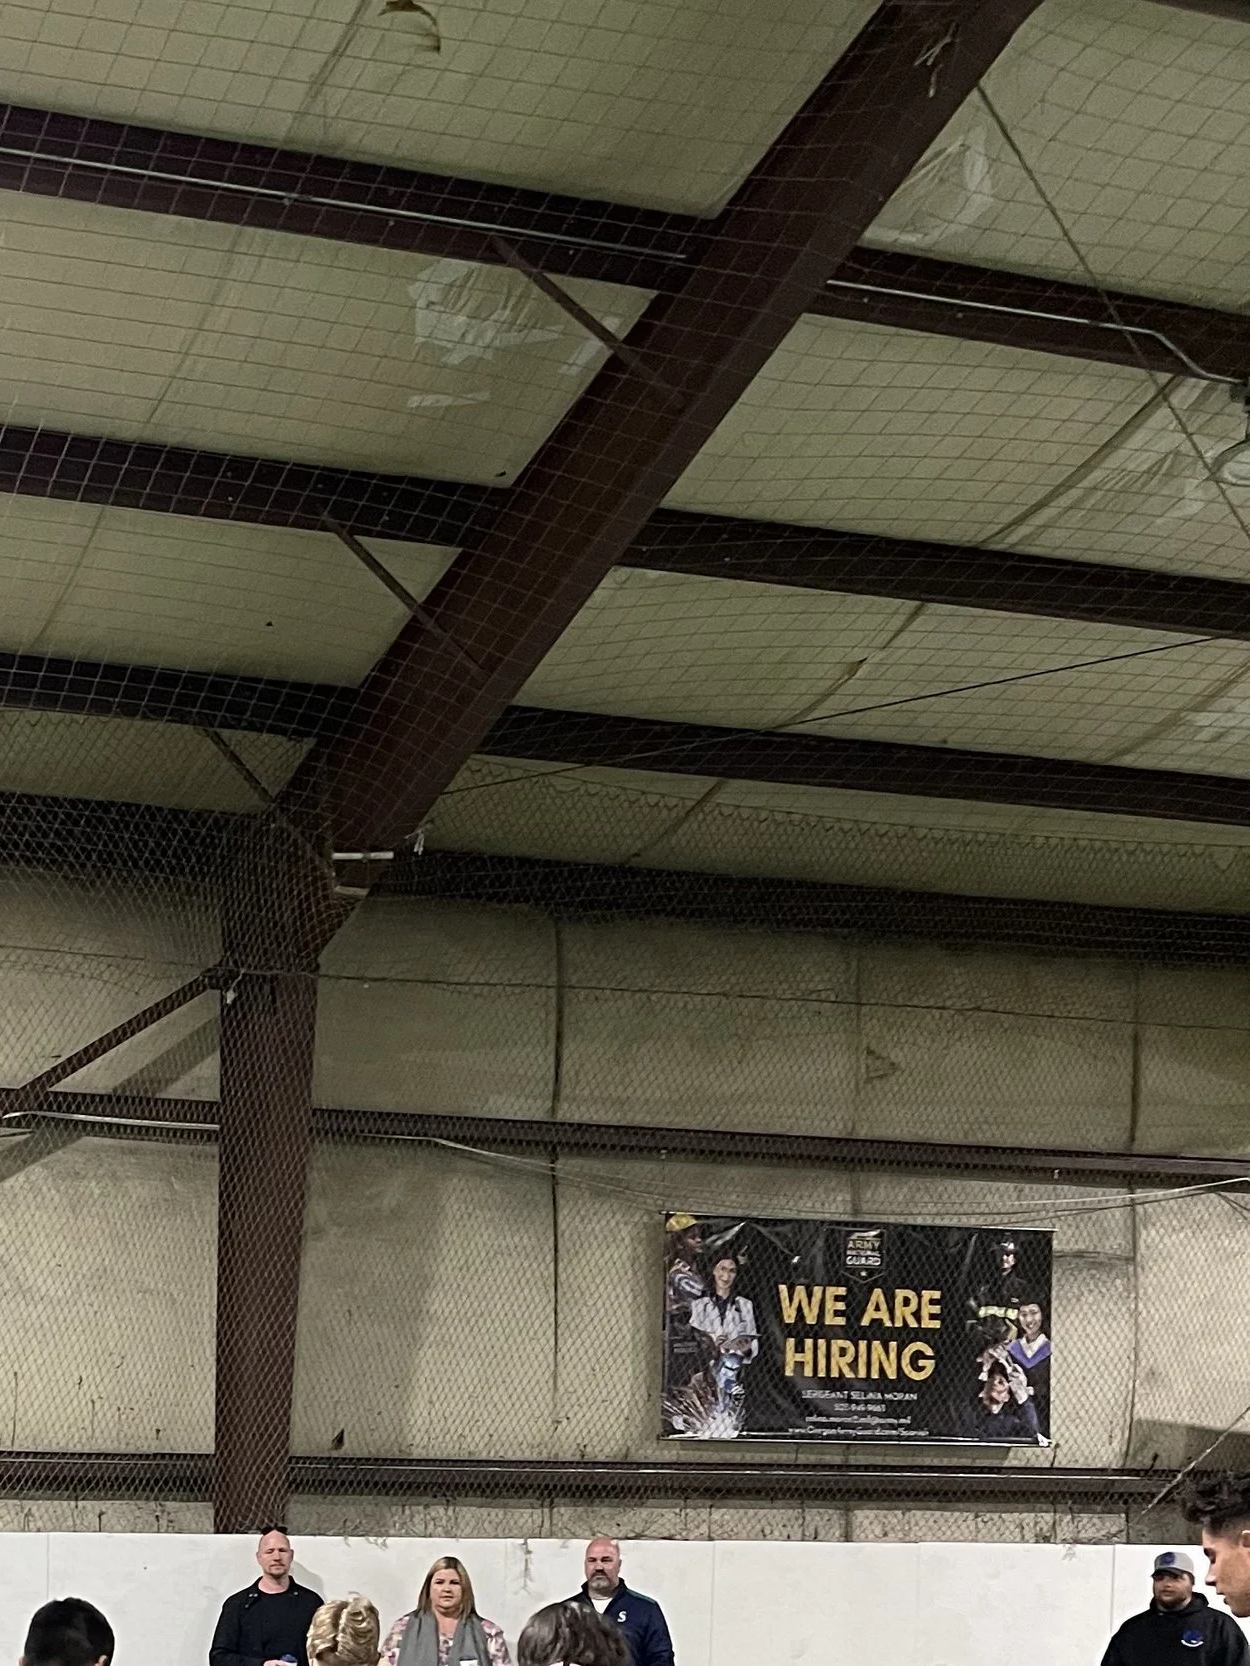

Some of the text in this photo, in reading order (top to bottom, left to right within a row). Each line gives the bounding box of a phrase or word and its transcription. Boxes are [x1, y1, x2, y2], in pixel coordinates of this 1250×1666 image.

[778, 1284, 942, 1329] WE ARE
[784, 1338, 936, 1381] HIRING
